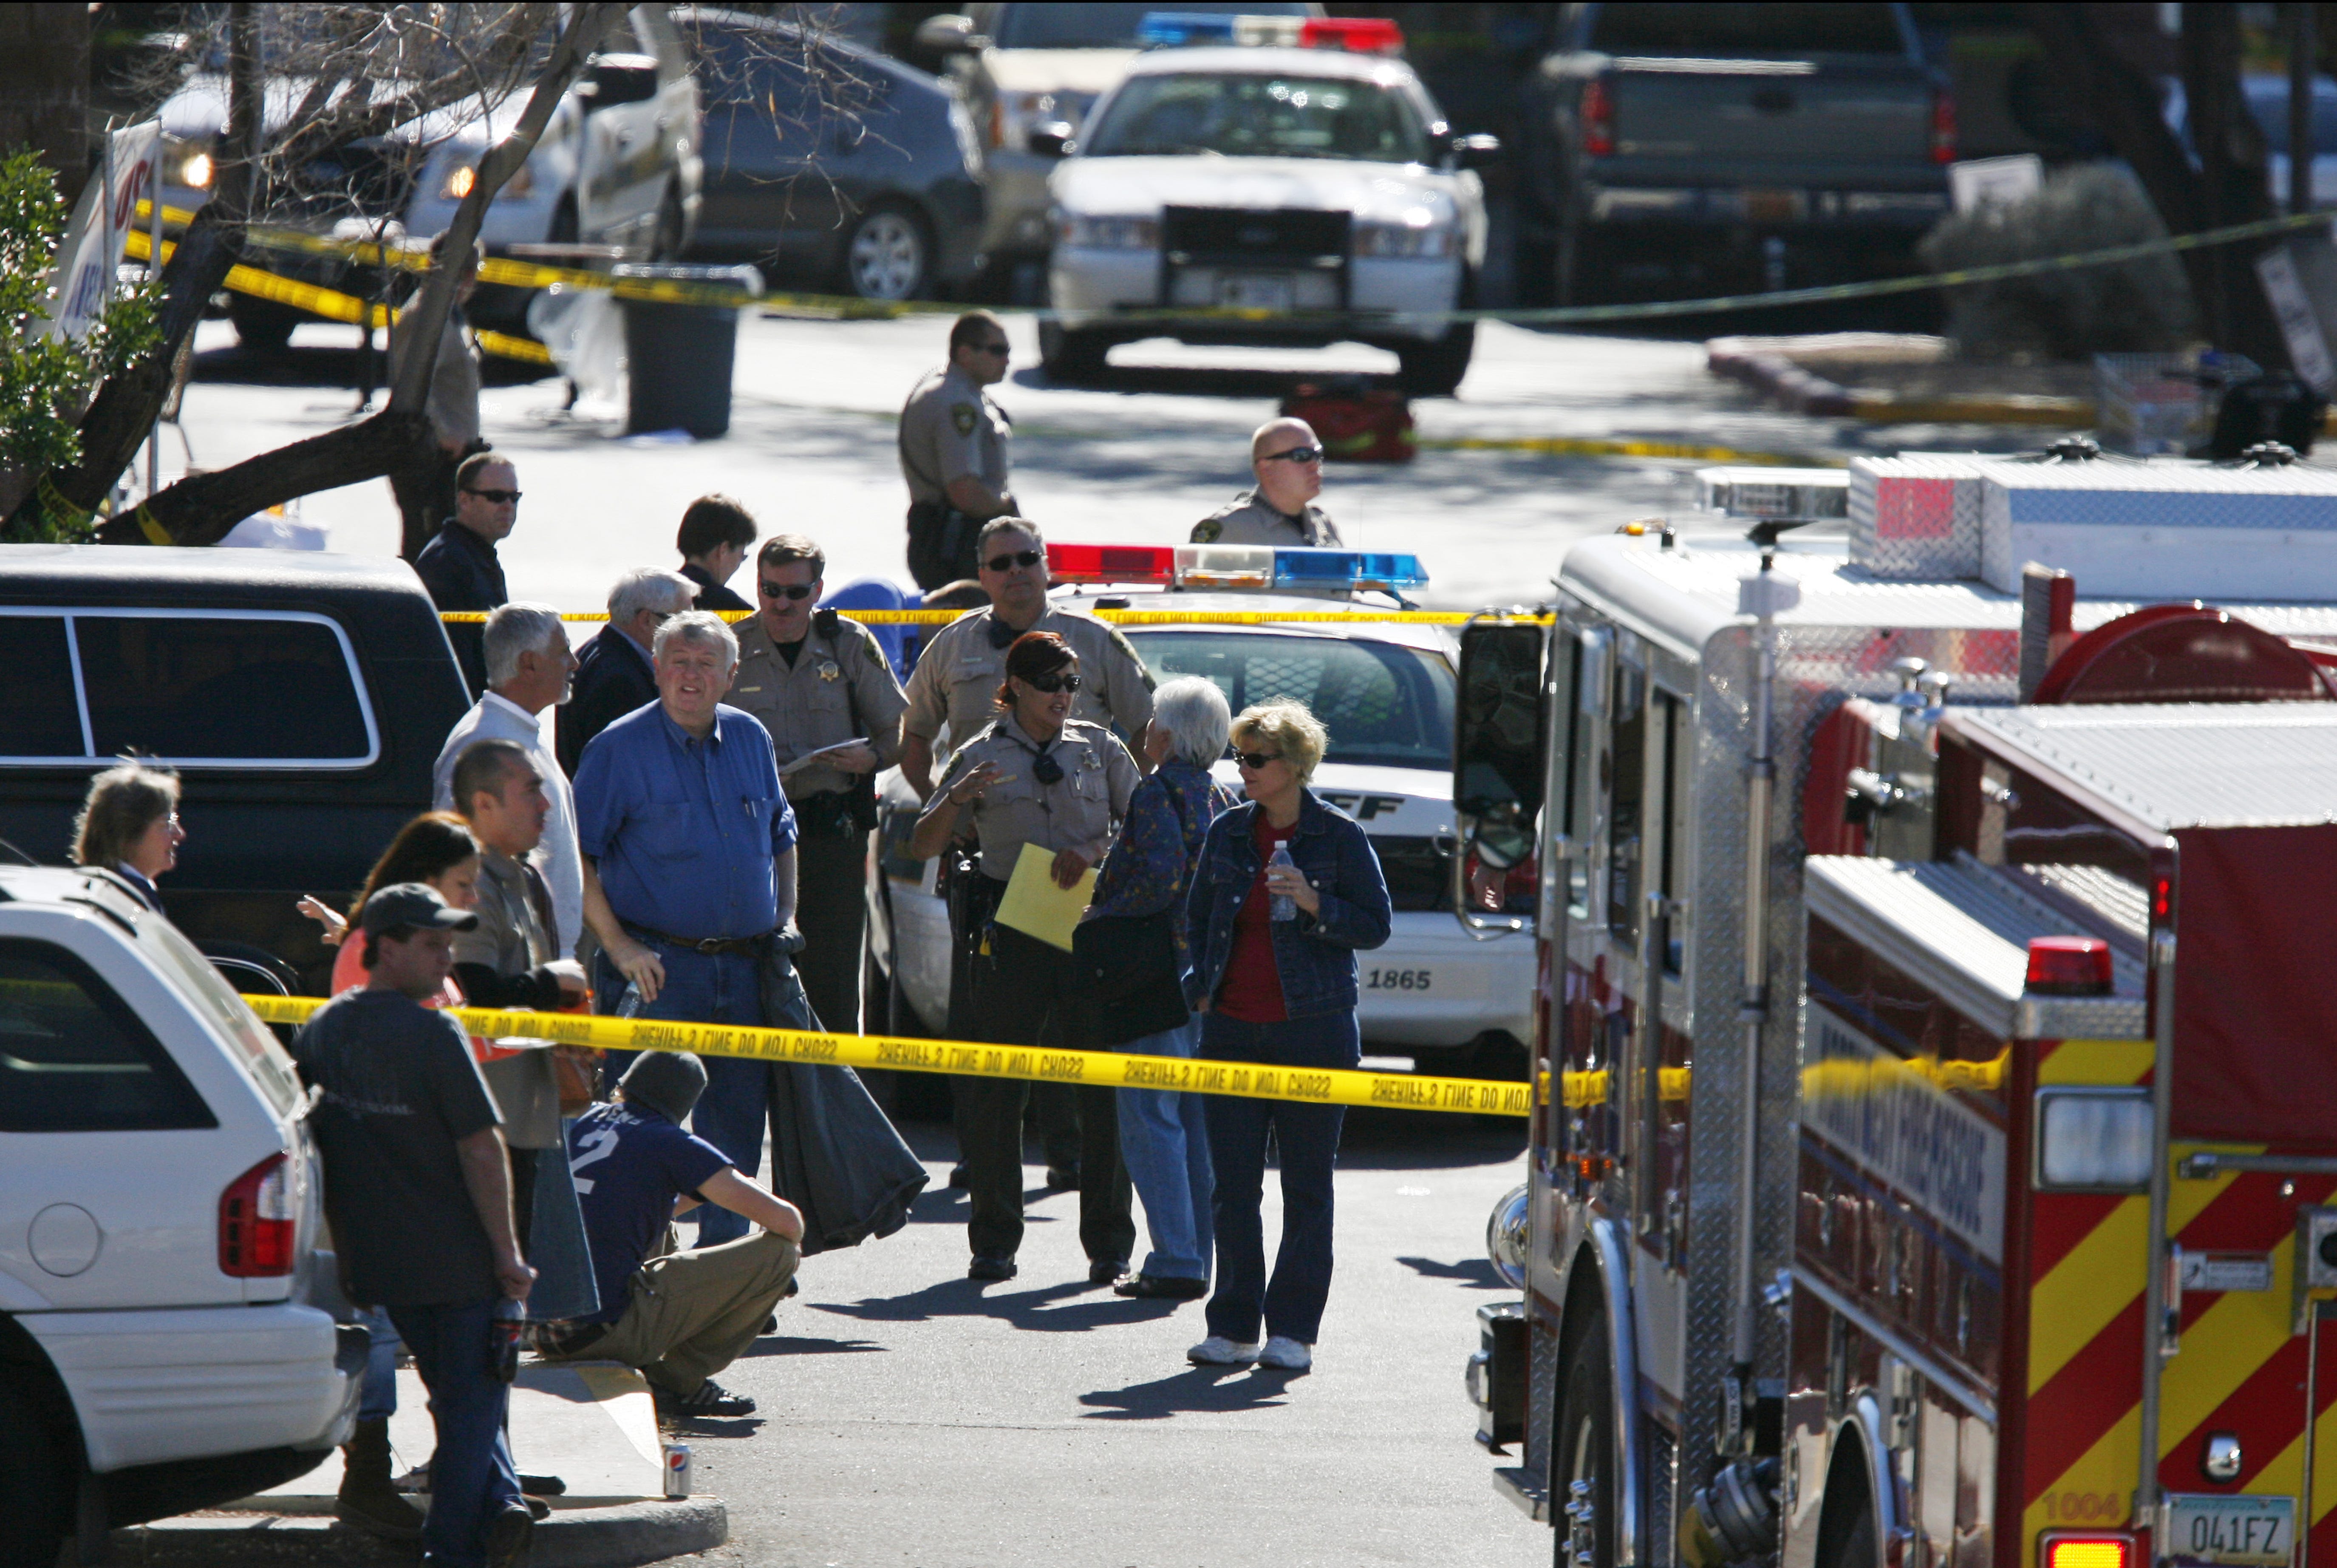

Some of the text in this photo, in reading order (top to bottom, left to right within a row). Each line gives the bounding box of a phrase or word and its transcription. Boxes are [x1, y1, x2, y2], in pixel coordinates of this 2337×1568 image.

[1367, 969, 1431, 990] 1865
[2044, 1492, 2121, 1521] 1004
[2192, 1515, 2280, 1554] 041FZ
